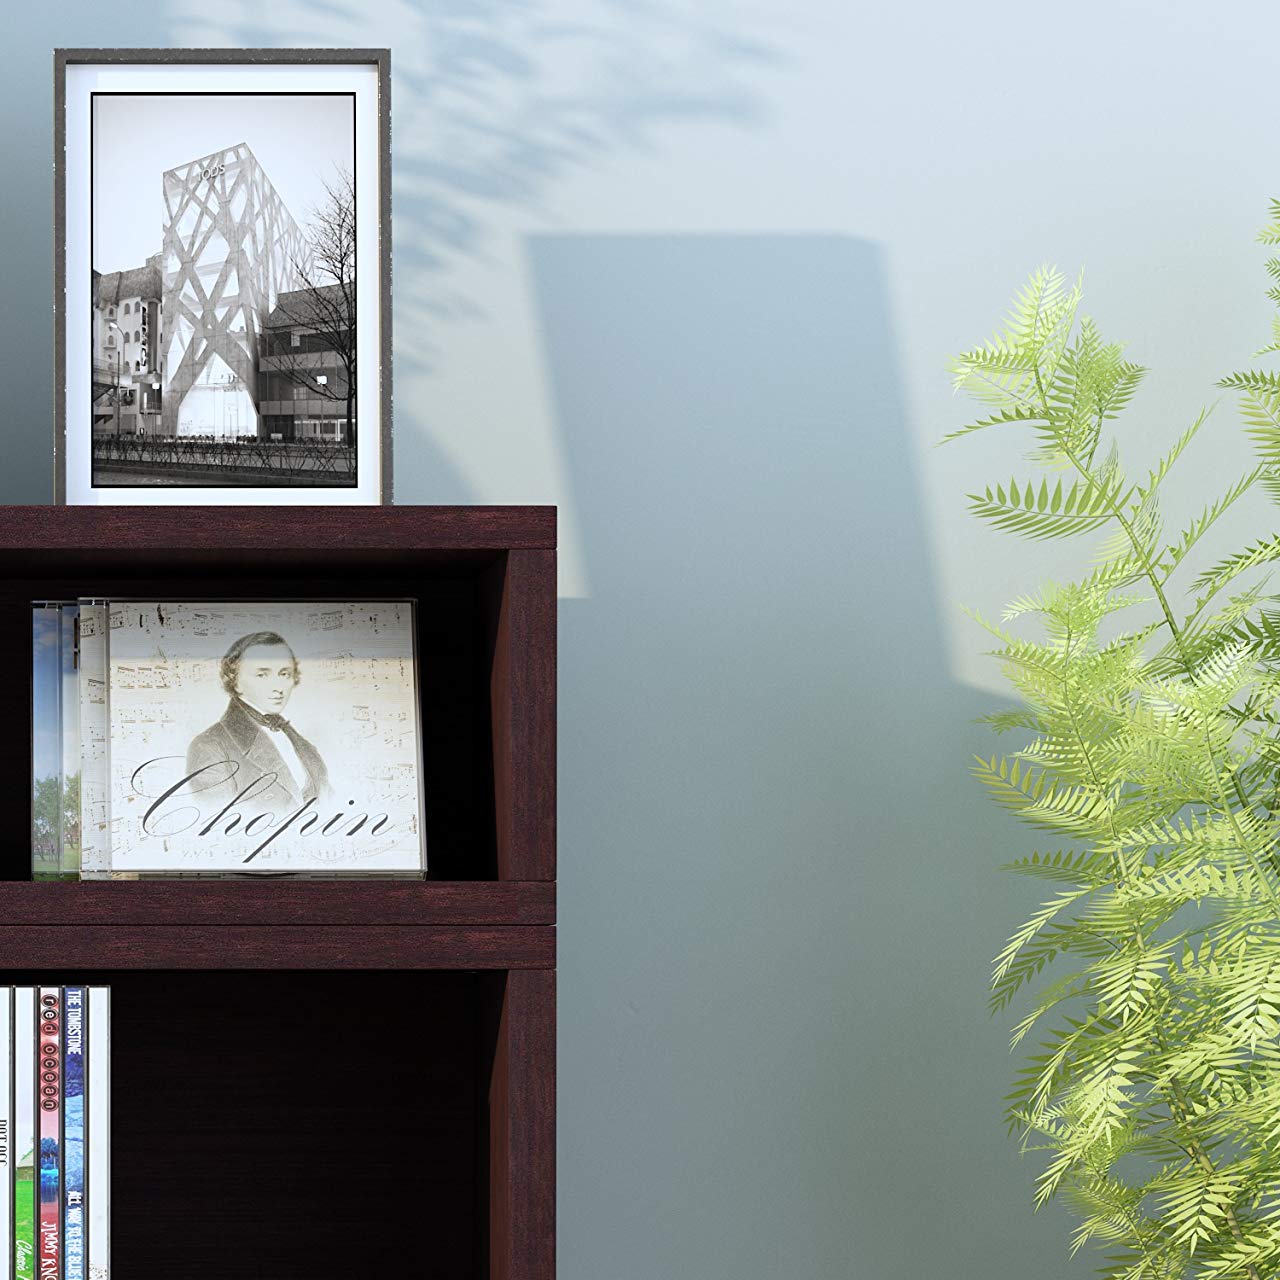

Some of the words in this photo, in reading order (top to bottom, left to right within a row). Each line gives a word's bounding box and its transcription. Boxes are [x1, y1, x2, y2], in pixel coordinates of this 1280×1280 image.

[131, 756, 397, 864] Chopin
[67, 990, 80, 1006] THE
[67, 1007, 80, 1054] TOMBSTONE
[41, 1041, 58, 1111] ocean
[17, 1240, 33, 1270] Classic
[42, 1221, 57, 1254] JIMMY
